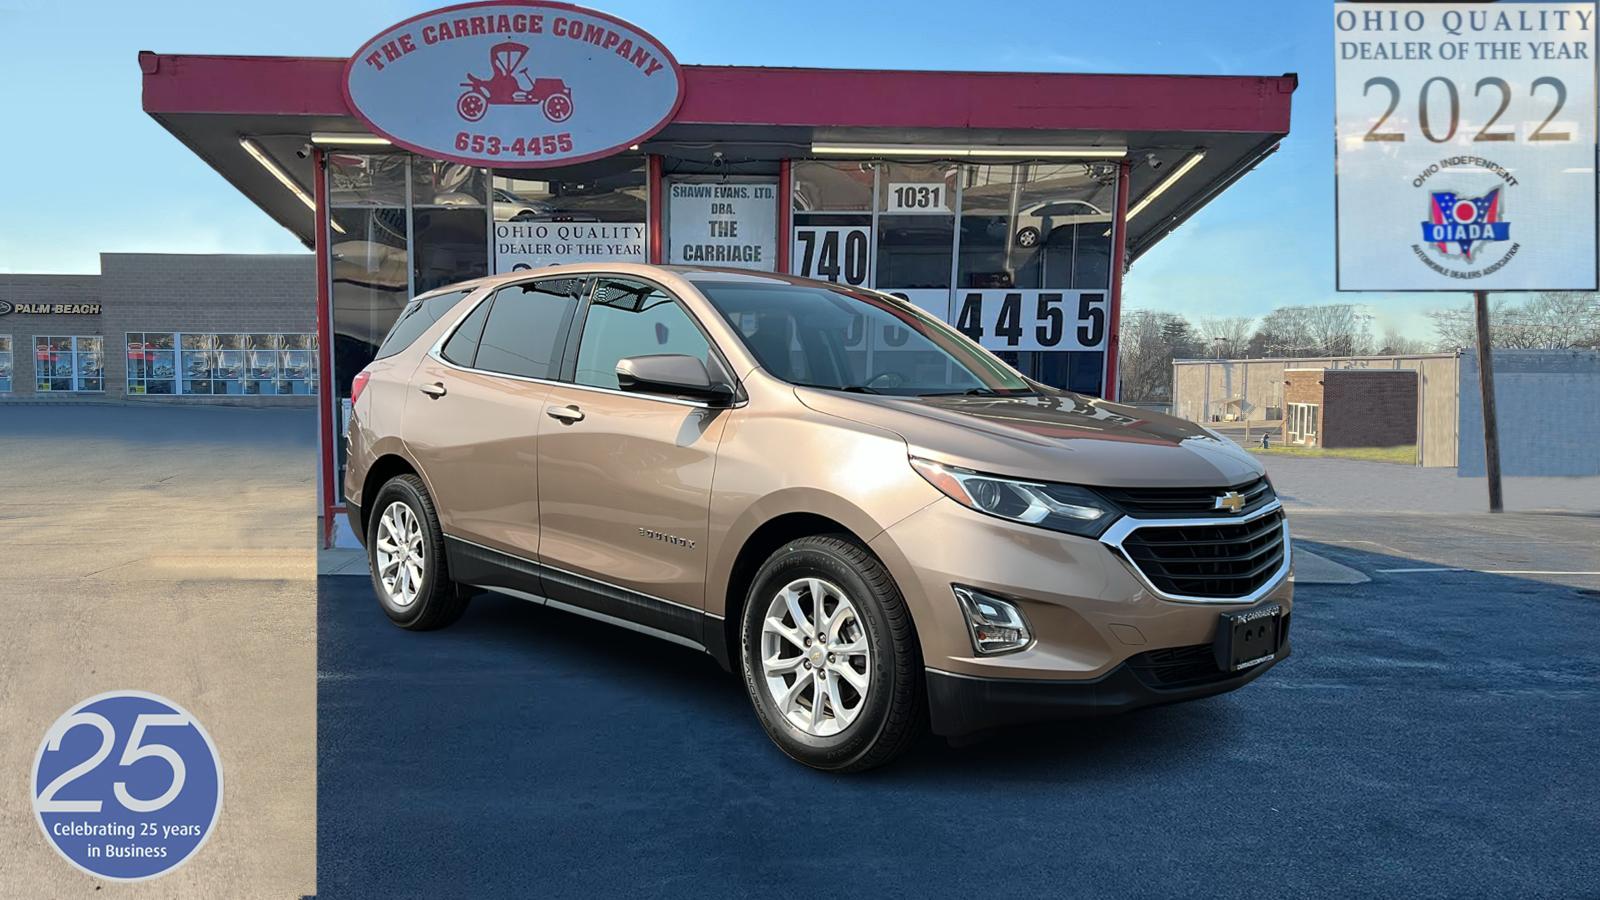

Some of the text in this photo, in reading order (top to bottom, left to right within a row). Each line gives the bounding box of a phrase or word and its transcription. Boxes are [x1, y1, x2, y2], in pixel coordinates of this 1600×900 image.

[1336, 10, 1593, 35] OHIO QUALITY
[365, 14, 664, 77] THE CARRIAGE COMPANY
[1341, 42, 1589, 60] DEALER OF THE YEAR
[1362, 76, 1571, 143] 2022
[455, 131, 573, 156] 653-4455
[1412, 155, 1519, 188] OHIO INDEPENDENT
[672, 186, 712, 199] SHAWN
[754, 187, 774, 199] LTD.
[894, 187, 940, 208] 1031
[711, 203, 735, 215] DBA.
[497, 226, 645, 241] OHIO QUALITY
[709, 221, 737, 238] THE
[1432, 224, 1495, 240] OIADA
[499, 243, 641, 255] DEALER OF THE YEAR
[683, 244, 762, 262] CARRIAGE
[797, 230, 868, 285] 740
[14, 303, 100, 314] PALM BEACH
[956, 292, 1105, 347] 4455
[638, 527, 695, 548] EQUINOX
